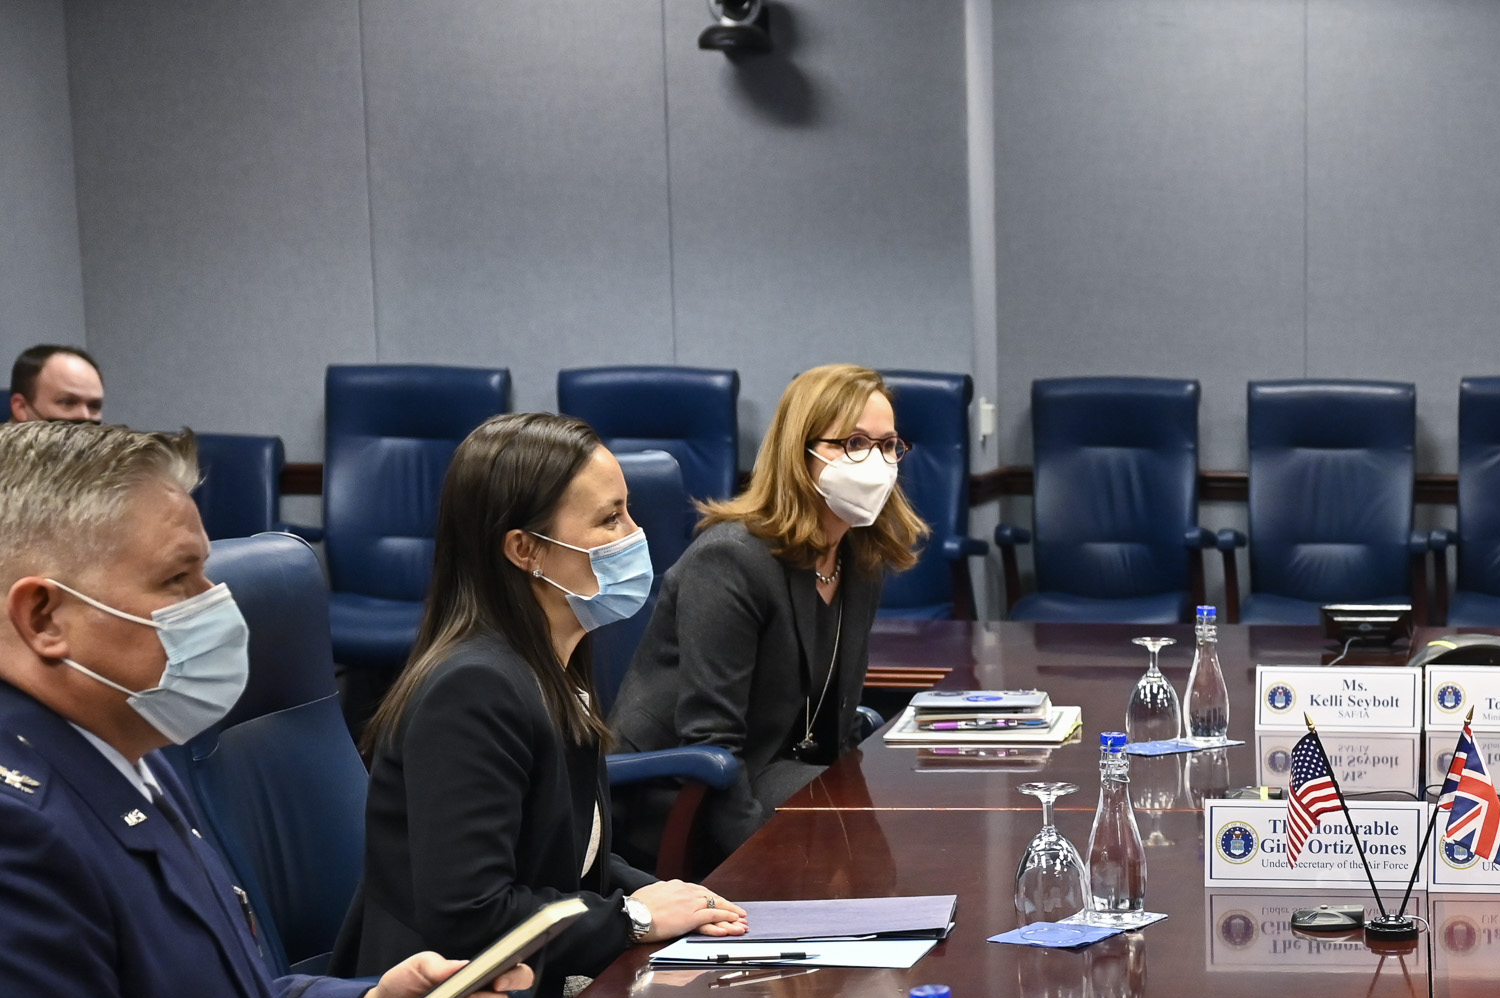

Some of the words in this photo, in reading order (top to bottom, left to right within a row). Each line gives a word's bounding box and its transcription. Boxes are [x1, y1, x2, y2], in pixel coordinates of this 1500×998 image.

[1342, 679, 1368, 692] Ms.
[1309, 694, 1343, 707] Kelli
[1347, 695, 1399, 711] Seybolt
[1338, 710, 1370, 719] SAF/IA
[1268, 819, 1287, 834] Th
[1260, 838, 1287, 854] Gi
[1308, 839, 1353, 854] Ortiz
[1361, 840, 1407, 855] Jones
[1261, 859, 1288, 868] Under
[1337, 860, 1349, 869] of
[1350, 860, 1363, 869] the
[1383, 860, 1409, 870] Force
[1482, 861, 1499, 871] UK
